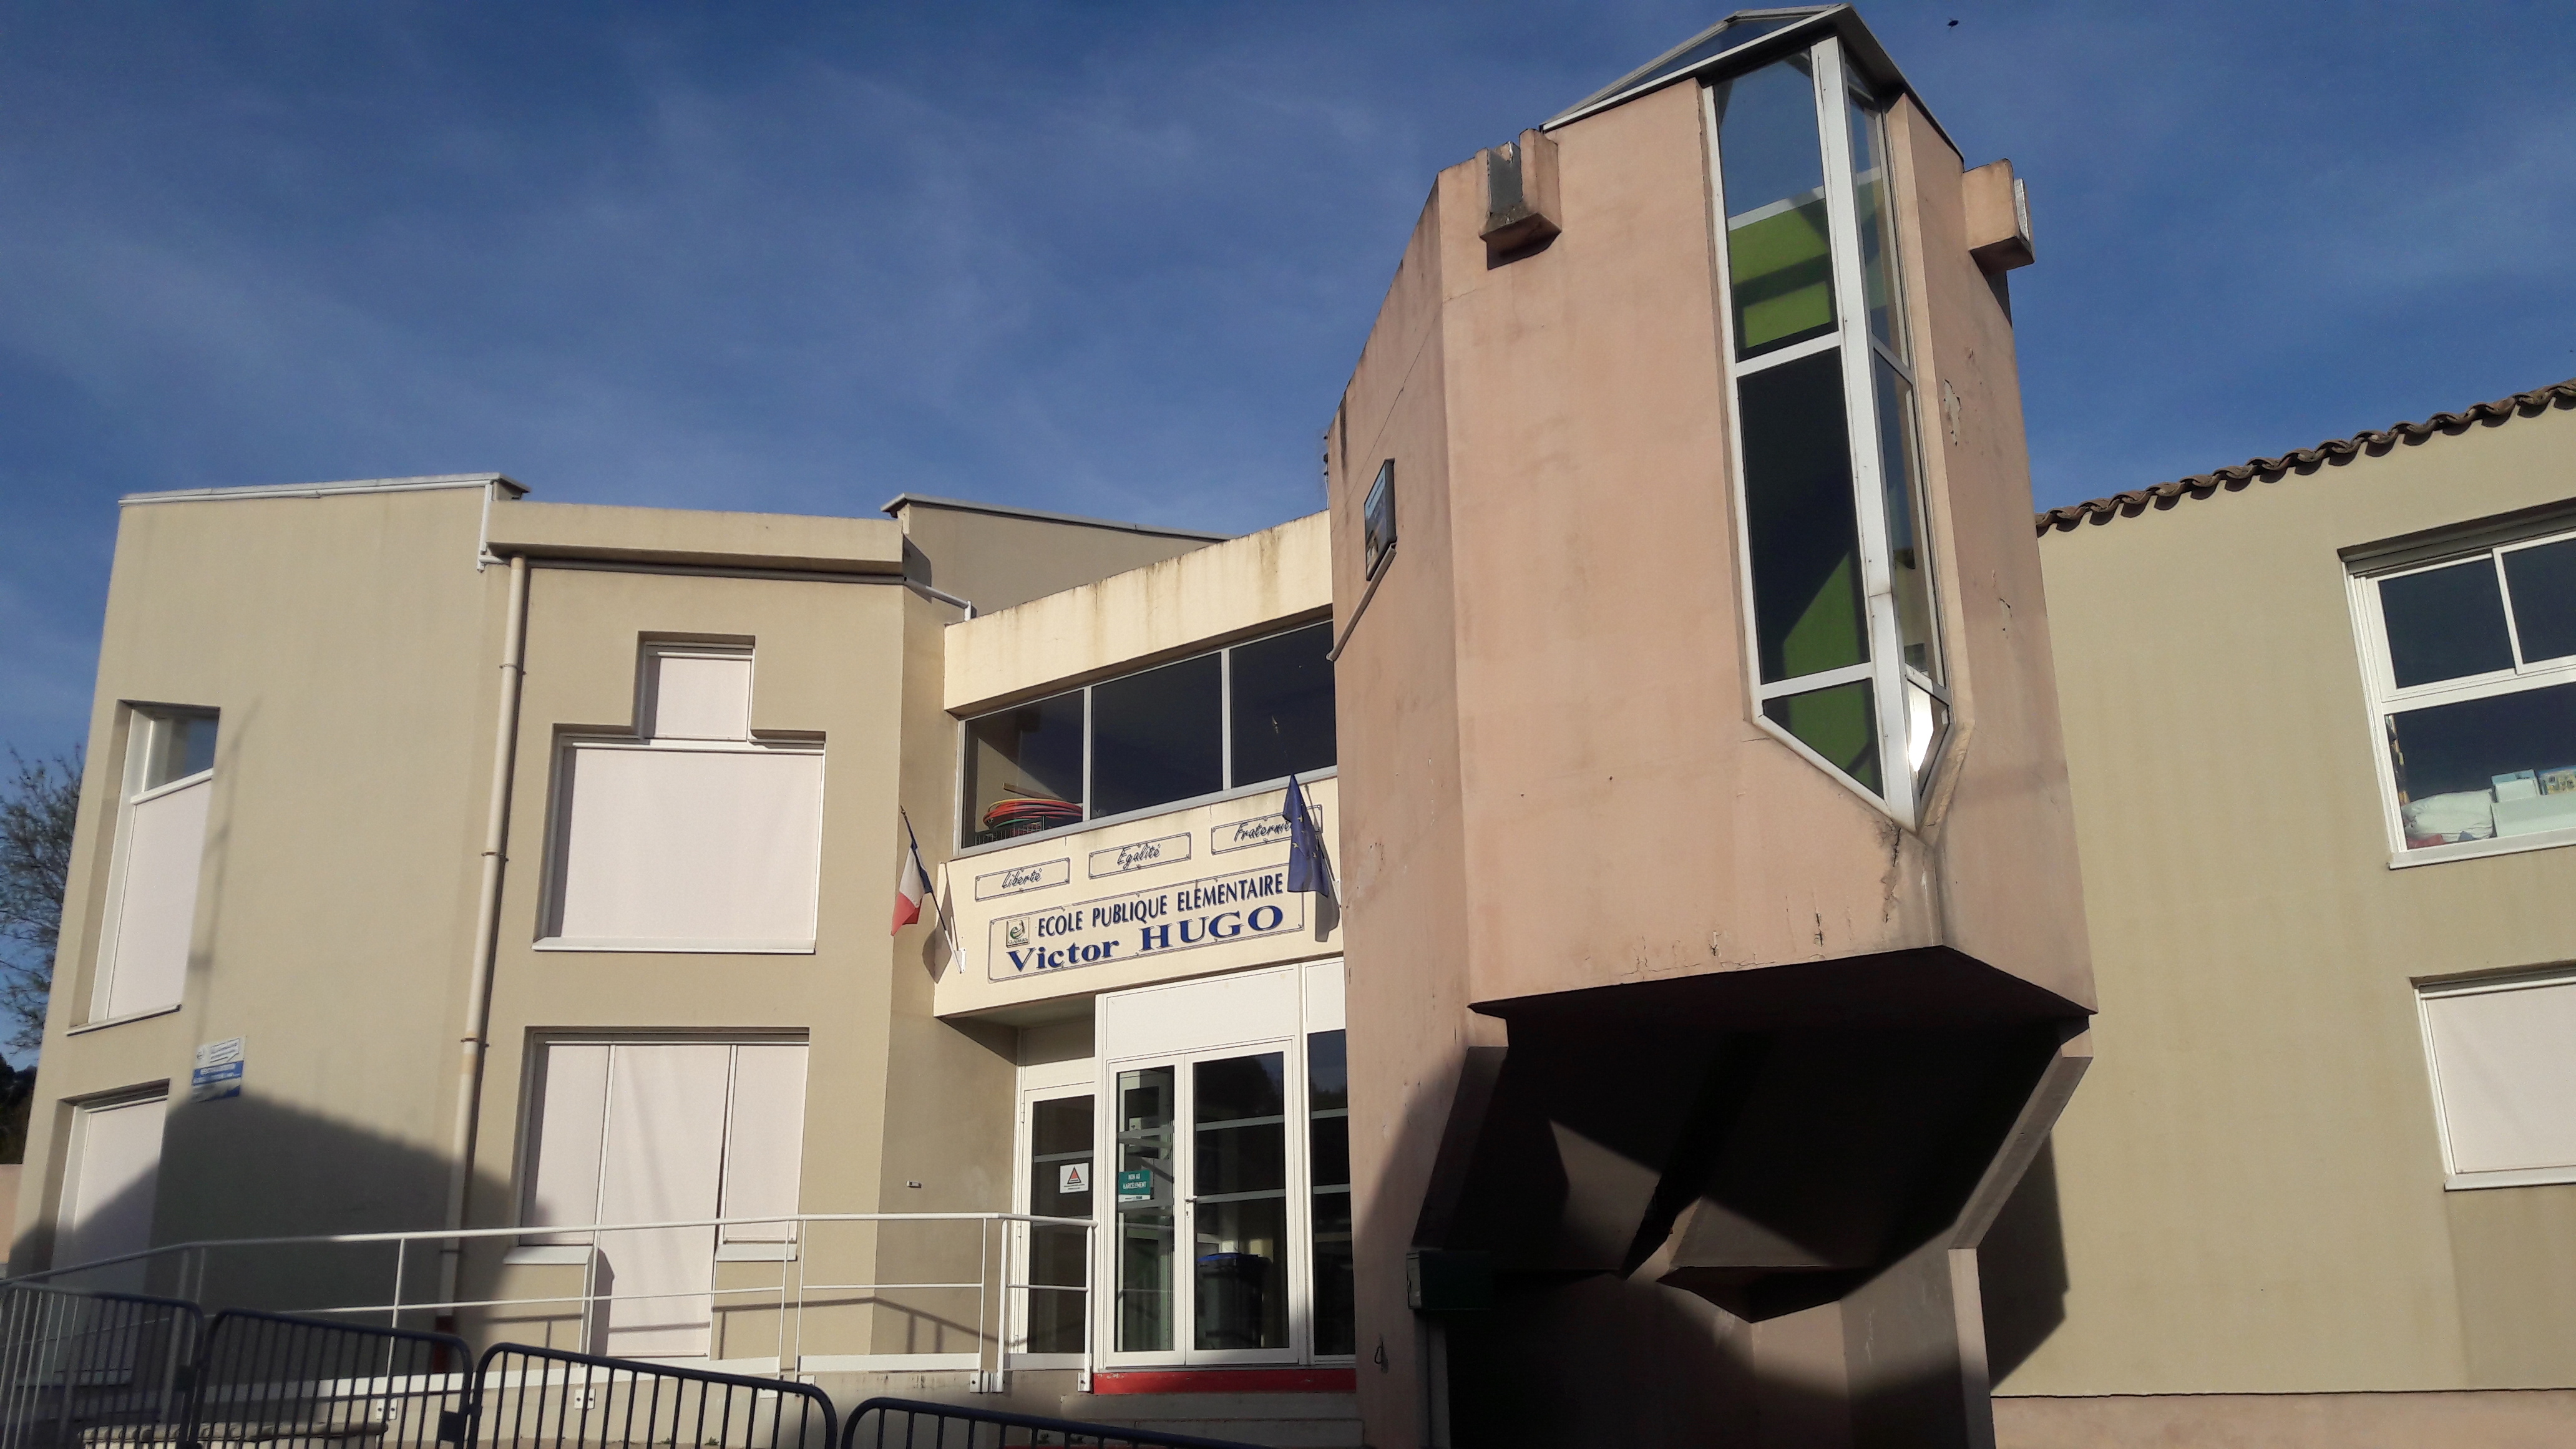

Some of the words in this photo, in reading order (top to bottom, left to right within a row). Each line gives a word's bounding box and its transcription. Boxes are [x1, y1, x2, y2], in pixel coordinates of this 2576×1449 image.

[1234, 821, 1292, 842] Fraternit
[1002, 868, 1043, 889] Liberté
[1037, 910, 1083, 937] ECOLE
[1092, 894, 1168, 927] PUBLIQUE
[1006, 940, 1120, 972] Victor
[1138, 905, 1283, 952] HUGO
